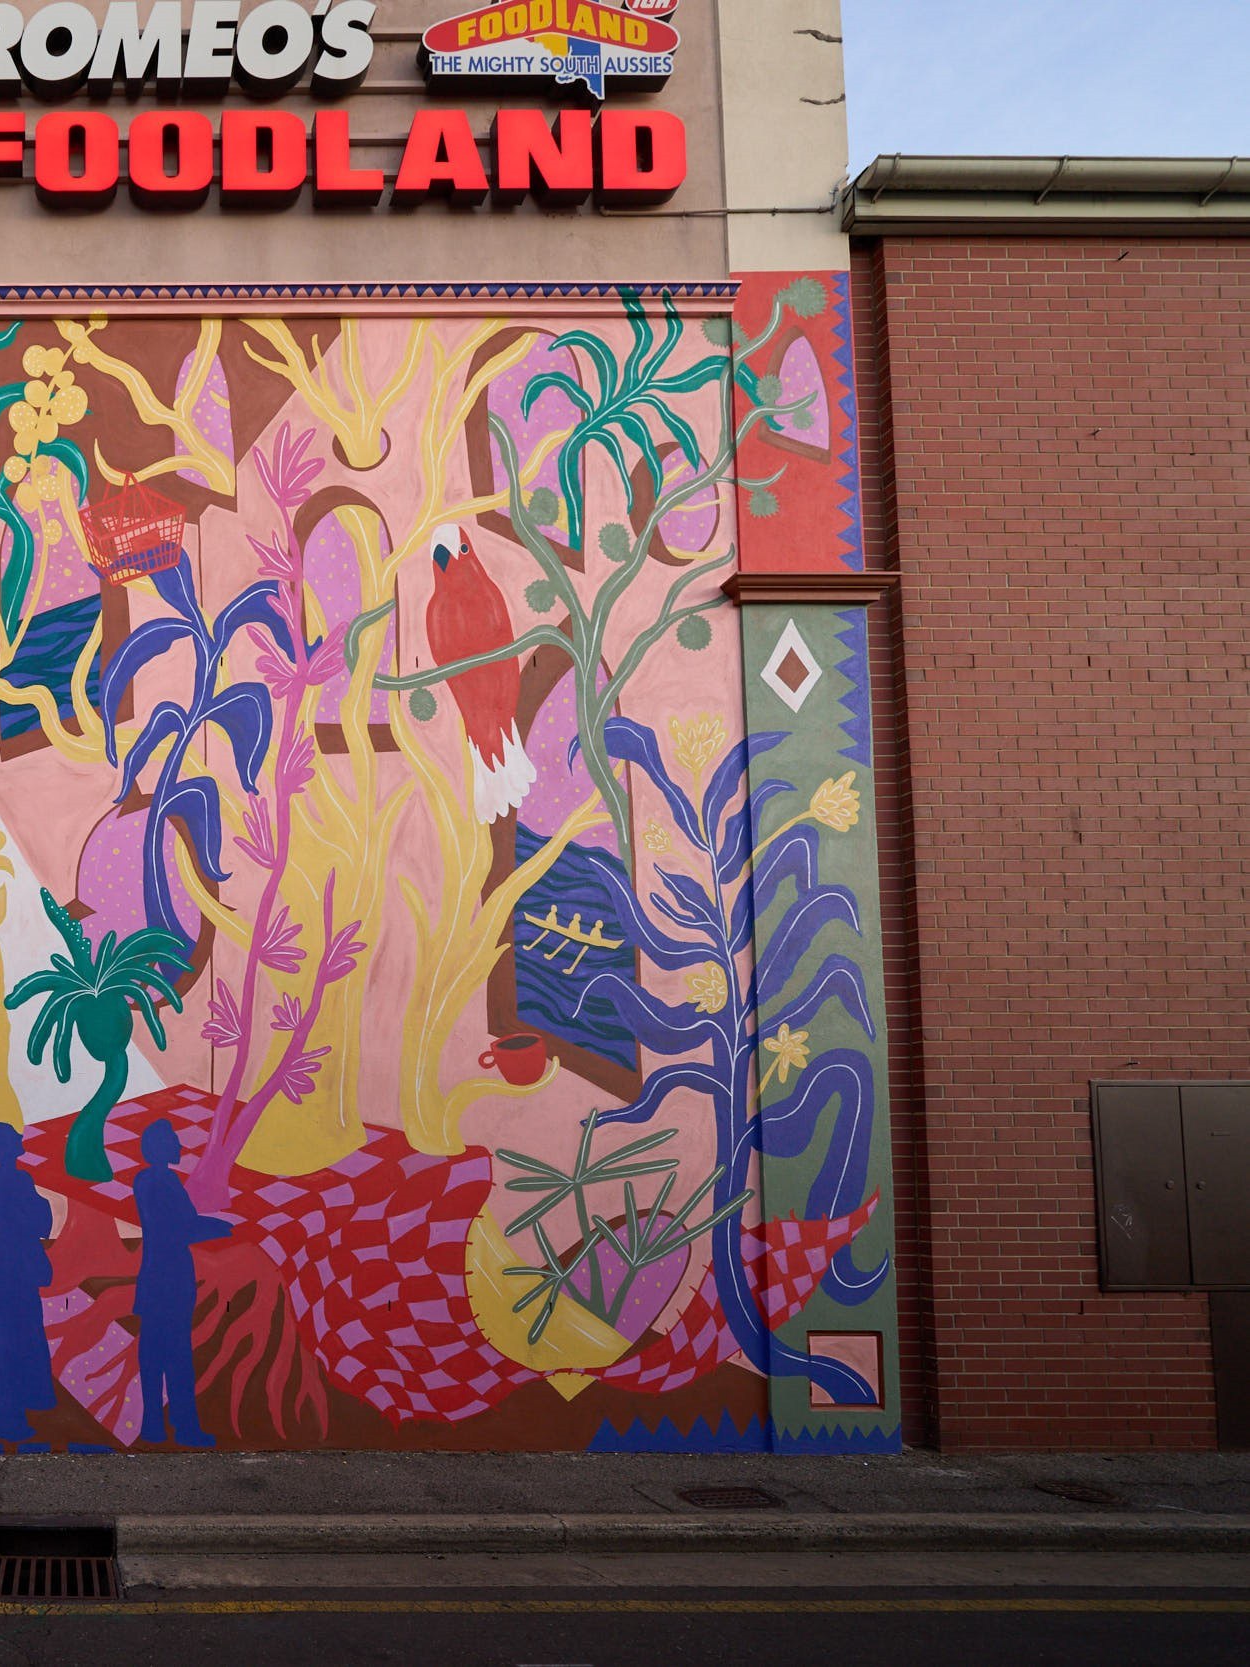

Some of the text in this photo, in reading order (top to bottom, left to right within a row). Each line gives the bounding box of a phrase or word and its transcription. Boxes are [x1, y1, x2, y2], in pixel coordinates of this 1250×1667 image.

[458, 0, 648, 46] FOODLAND
[431, 55, 673, 74] THE MIGHTY SOUTH AUSSIES
